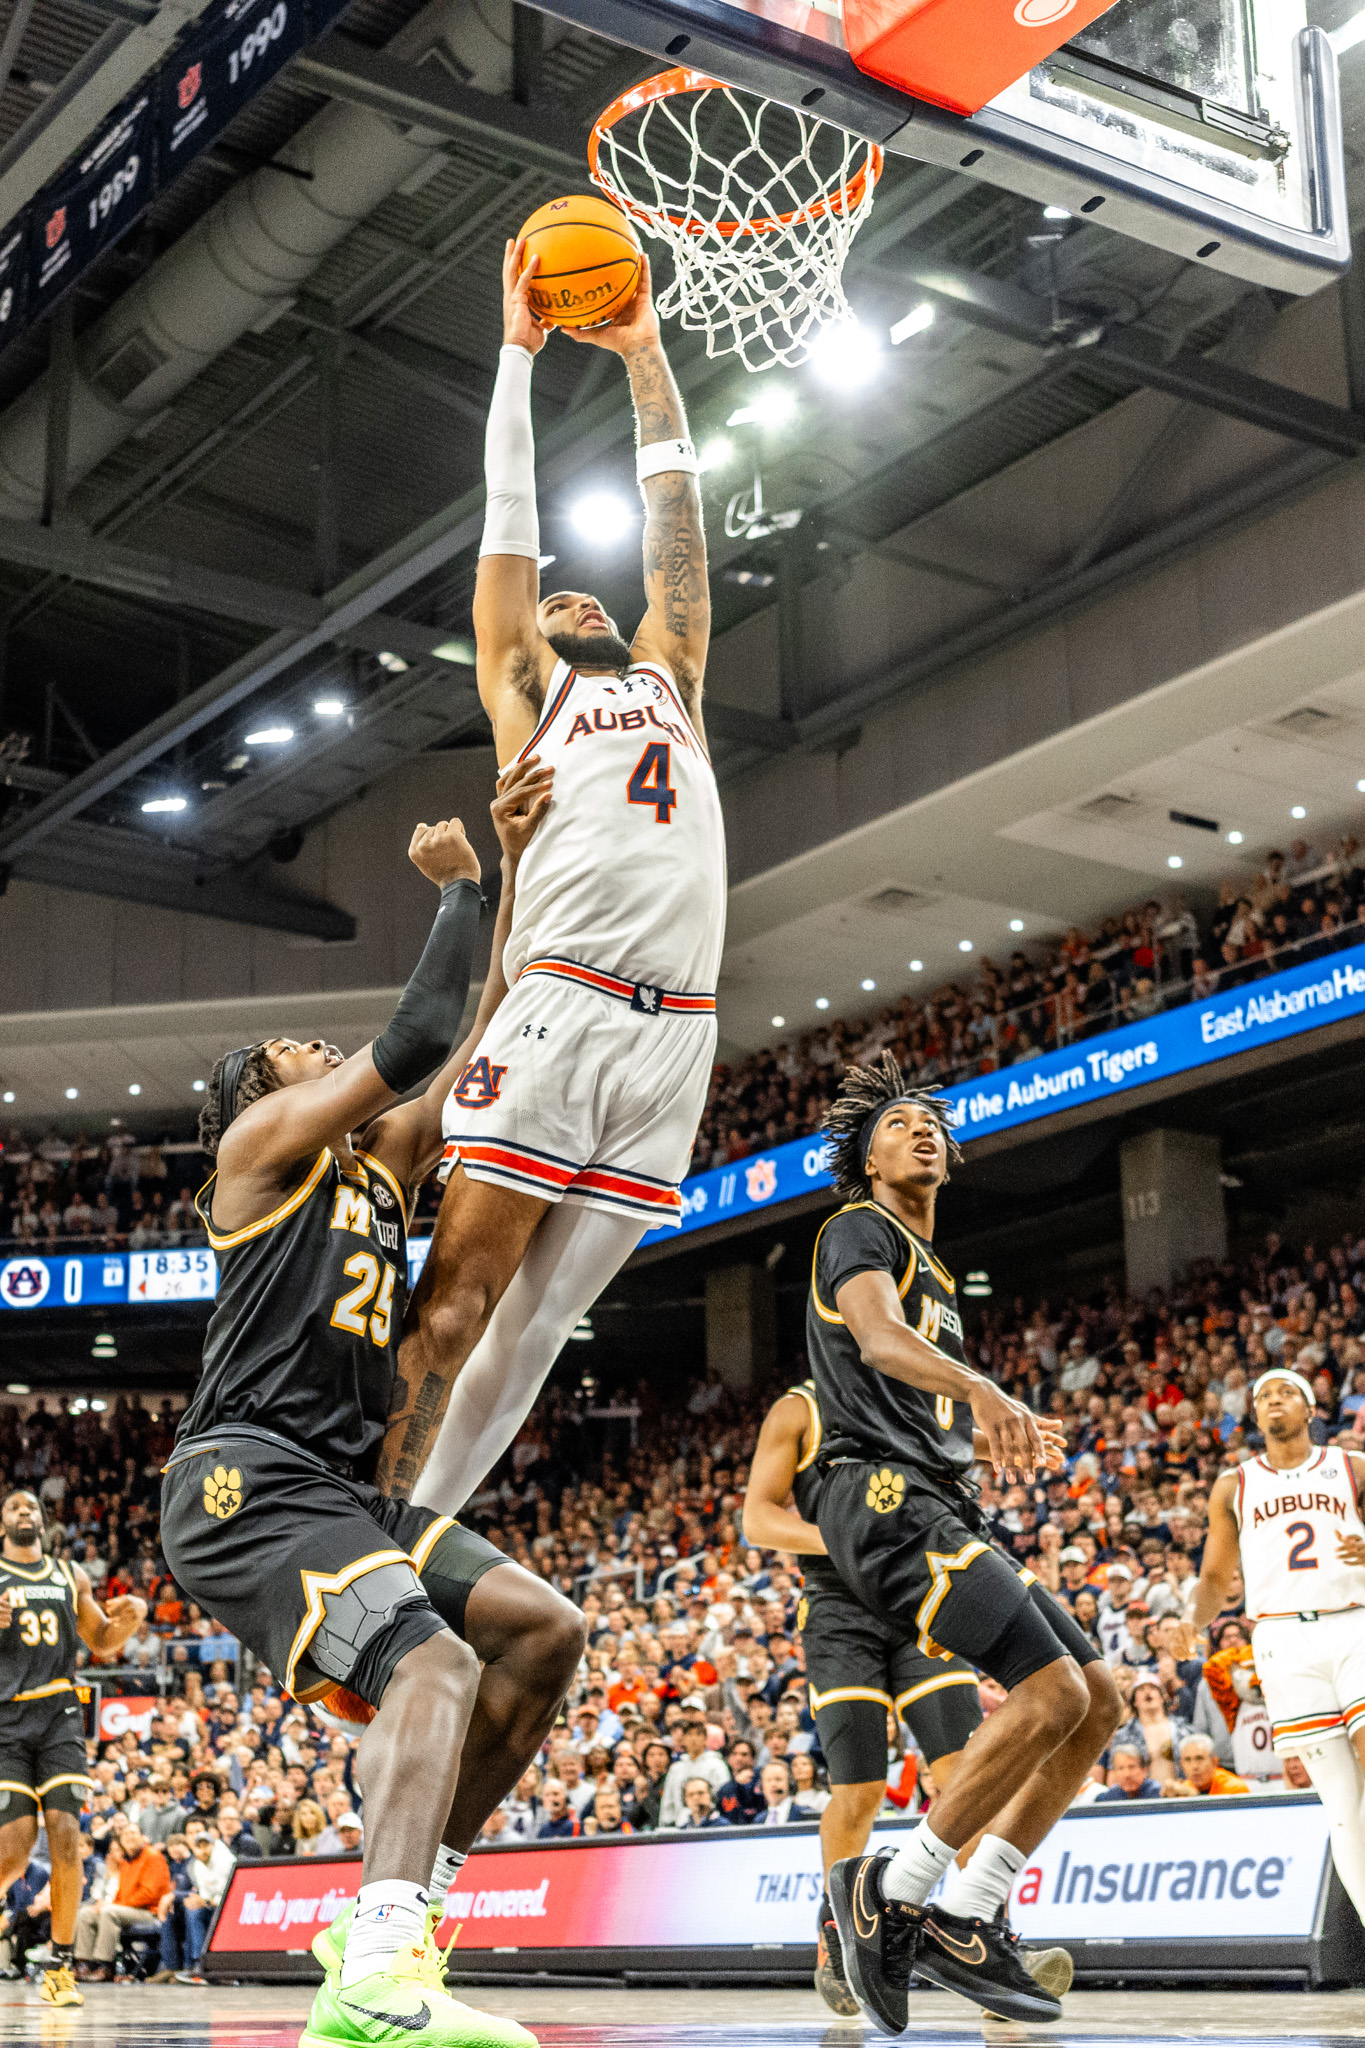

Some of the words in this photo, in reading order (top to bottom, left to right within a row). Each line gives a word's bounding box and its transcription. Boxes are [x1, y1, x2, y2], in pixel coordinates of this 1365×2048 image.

[228, 1, 287, 85] 1990
[89, 155, 139, 230] 1989
[528, 281, 613, 309] Wilson
[626, 741, 677, 824] 4
[1200, 1006, 1245, 1044] East
[1245, 979, 1335, 1029] Alabama
[969, 1092, 1004, 1123] the
[1006, 1065, 1086, 1111] Auburn
[1087, 1041, 1159, 1084] Tigers
[64, 1259, 83, 1304] 0
[142, 1253, 209, 1275] 18:35
[330, 1251, 396, 1348] 25
[1253, 1493, 1347, 1529] AUBURN
[1284, 1520, 1319, 1572] 2
[19, 1609, 59, 1647] 33
[754, 1870, 823, 1903] THAT'S
[1052, 1851, 1285, 1905] Insurance
